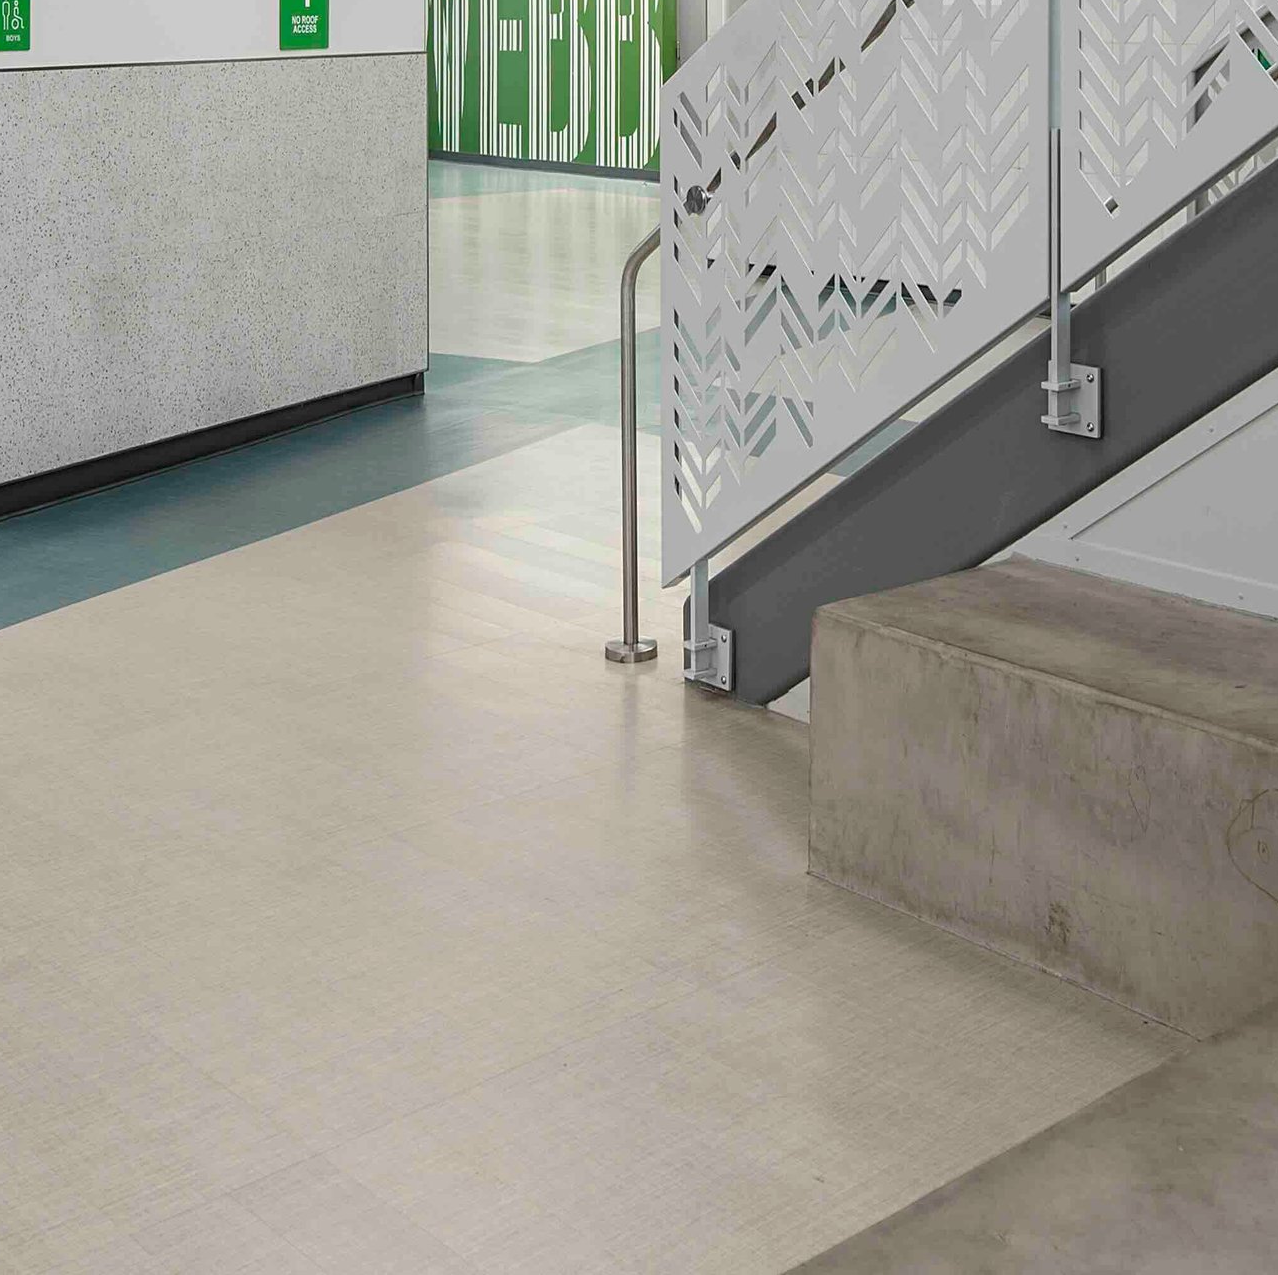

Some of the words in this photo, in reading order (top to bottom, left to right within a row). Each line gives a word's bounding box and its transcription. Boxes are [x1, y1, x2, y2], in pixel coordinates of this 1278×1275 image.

[291, 15, 301, 25] NO
[301, 15, 319, 25] ROOF
[293, 24, 317, 34] ACCESS
